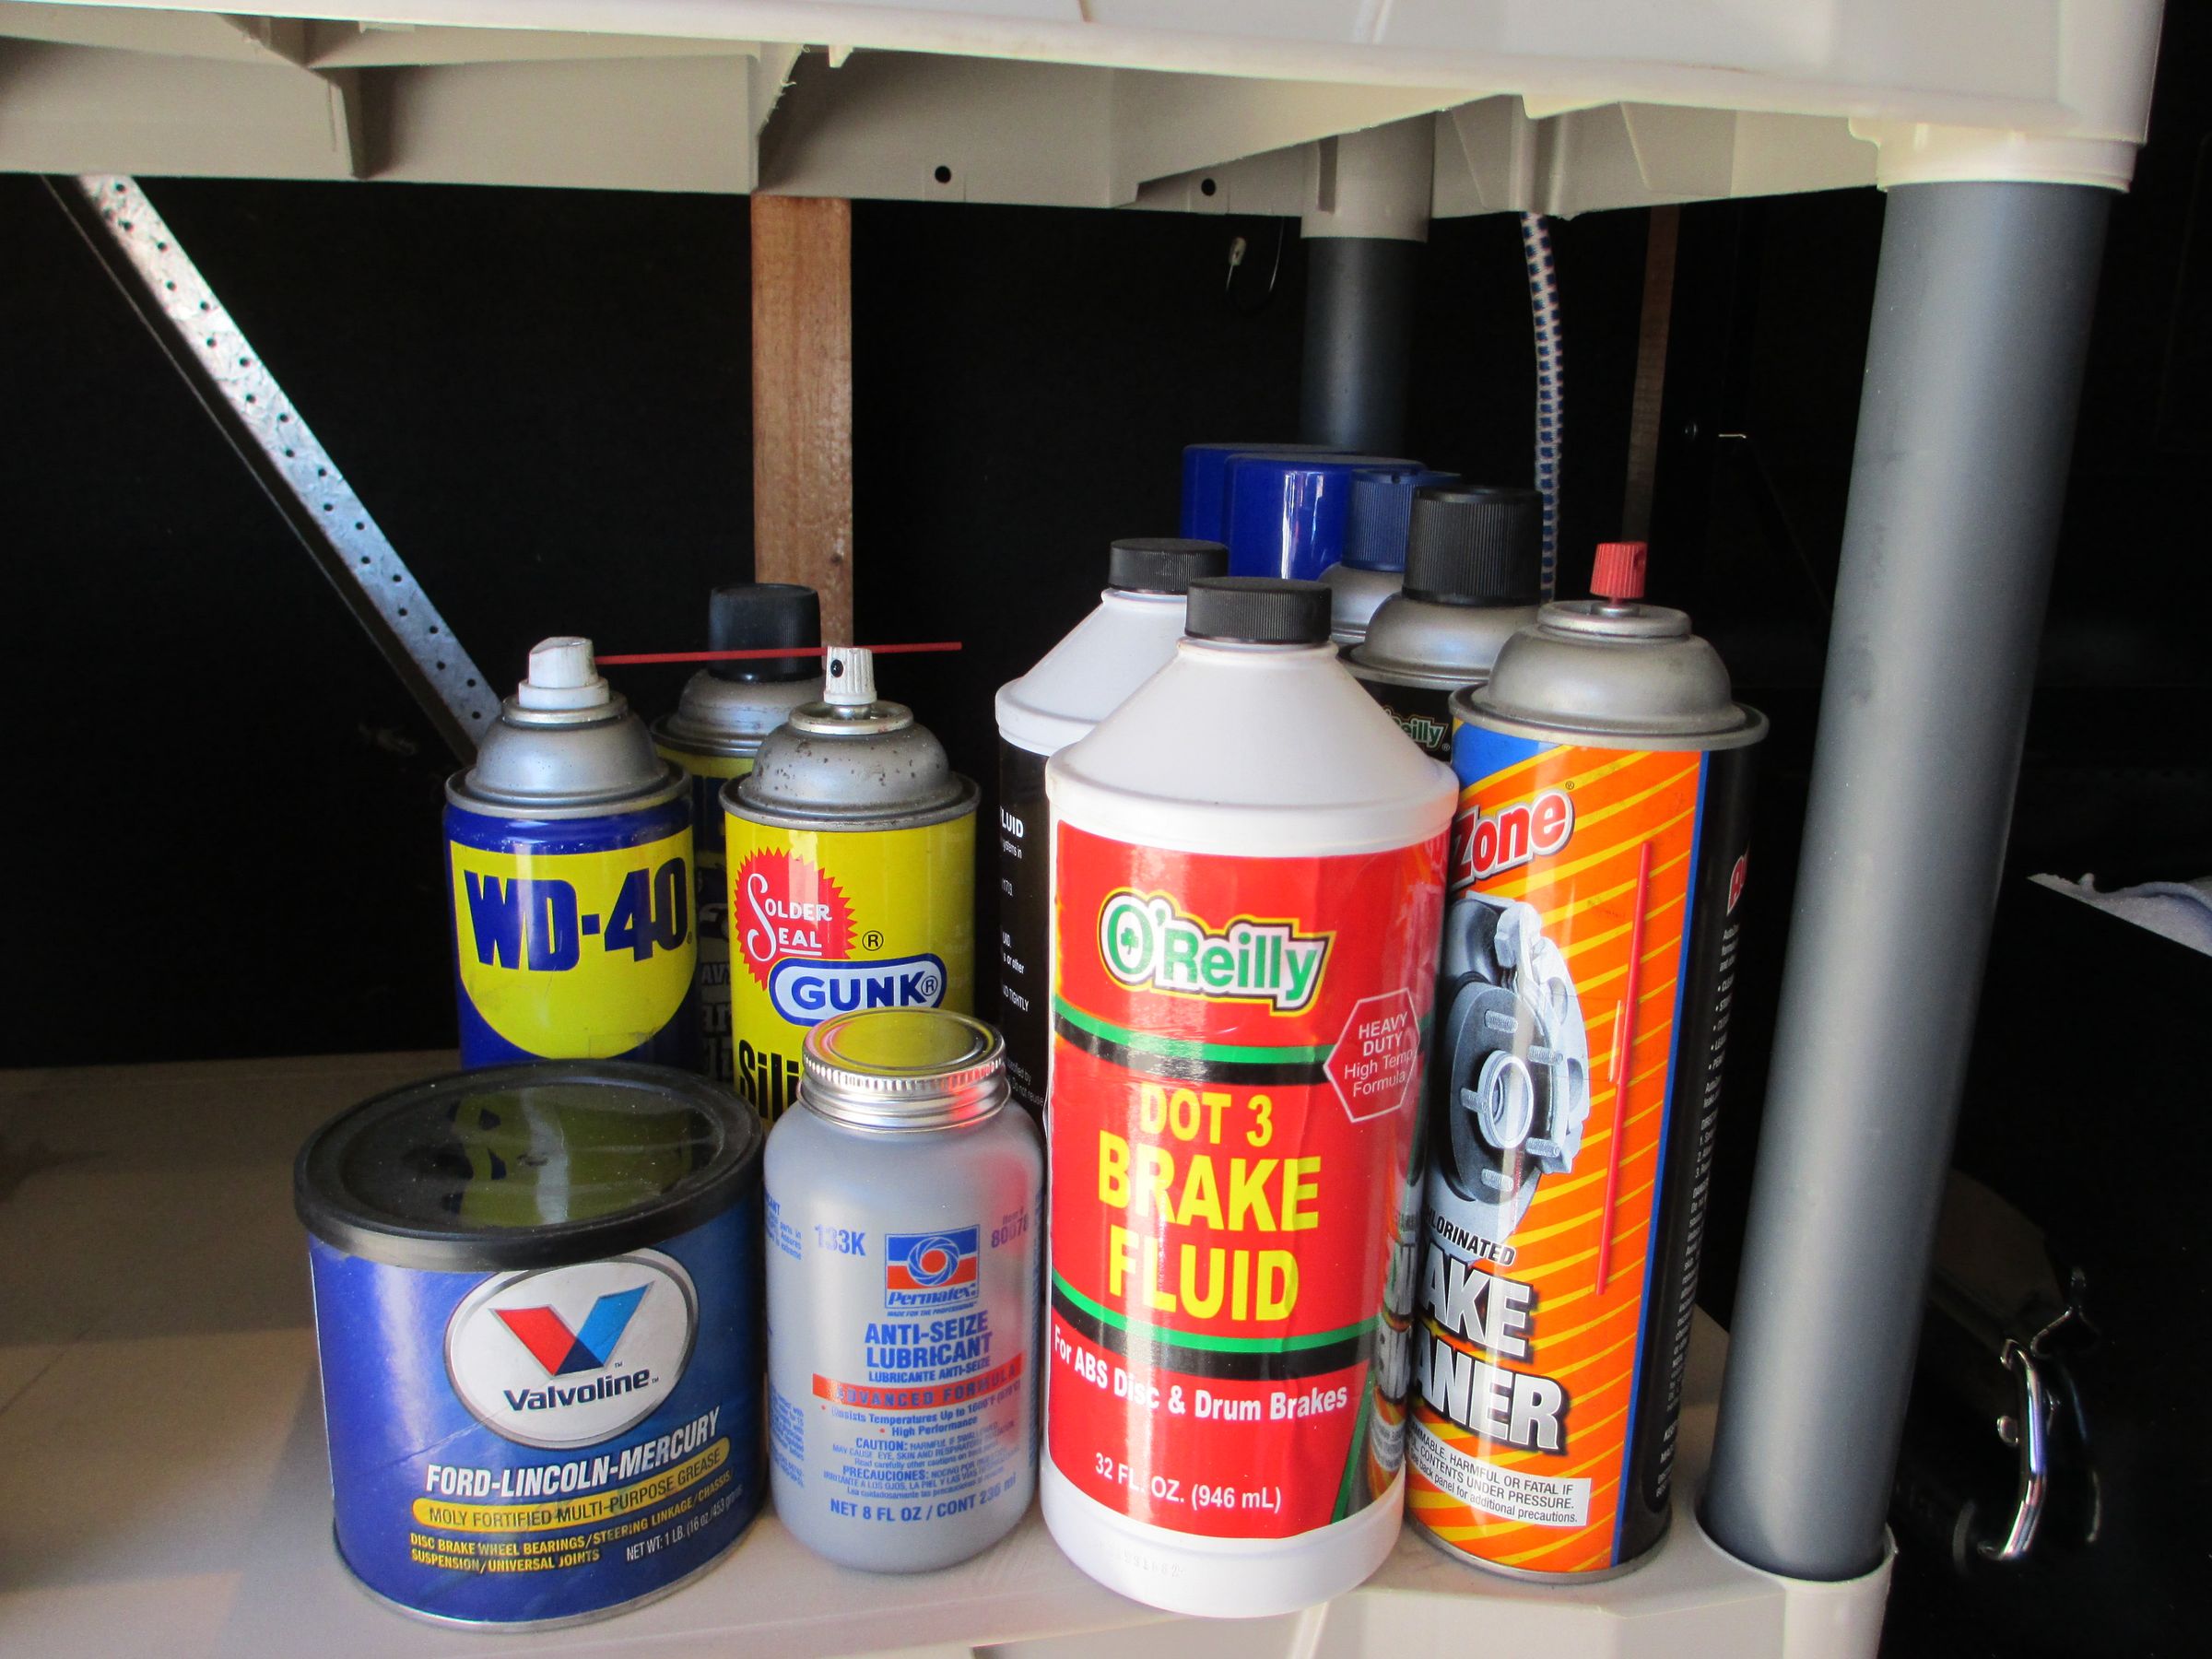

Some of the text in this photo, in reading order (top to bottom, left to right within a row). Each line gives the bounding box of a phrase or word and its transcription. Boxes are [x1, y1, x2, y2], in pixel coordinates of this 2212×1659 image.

[1000, 806, 1024, 838] LUID
[464, 857, 688, 971] WD-40
[747, 874, 832, 922] SOLDER
[1103, 898, 1324, 1006] O'Reilly
[791, 970, 926, 1011] GUNK
[1359, 1011, 1407, 1040] HEAVY
[1363, 1031, 1403, 1057] DUTY
[1344, 1059, 1378, 1080] High
[1352, 1070, 1406, 1098] Formula
[1140, 1081, 1273, 1147] DOT 3
[1099, 1130, 1322, 1233] BRAKE
[1109, 1225, 1300, 1322] FLUID
[865, 1310, 989, 1345] ANTI-SEIZE
[866, 1332, 993, 1369] LUBRICANT
[837, 1364, 1017, 1406] ADVANCED FORMULA
[869, 1357, 990, 1383] LUBRICANTE ANTI-SEIZE
[1054, 1324, 1348, 1420] For ABS Disc & Drum Brakes
[504, 1369, 650, 1411] Valvoline
[869, 1413, 936, 1425] Temperatures
[940, 1410, 953, 1420] Up
[956, 1407, 965, 1418] to
[892, 1426, 915, 1438] High
[918, 1417, 978, 1436] Performance
[426, 1406, 721, 1498] FORD-LINCOLN-MERCURY
[856, 1437, 908, 1451] CAUTION:
[896, 1450, 914, 1460] SKIN
[917, 1449, 934, 1459] AND
[429, 1448, 721, 1527] MOLY FORTIFIED MULTI-PURPOSE GREASE
[842, 1465, 929, 1481] PRECAUCIONES:
[922, 1478, 936, 1488] PIEL
[1095, 1452, 1281, 1513] 32 FL. OZ. (946 mL)
[1419, 1457, 1434, 1479] back
[1434, 1472, 1455, 1493] panel
[1457, 1485, 1468, 1500] for
[1470, 1492, 1515, 1516] additional
[1518, 1506, 1578, 1524] precautions.
[1420, 1447, 1574, 1510] CONTENTS UNDER PRESSURE.
[1450, 1453, 1499, 1485] HARMFUL
[1504, 1475, 1520, 1489] OR
[1524, 1480, 1559, 1495] FATAL
[1562, 1484, 1574, 1495] IF
[830, 1497, 858, 1517] NET
[863, 1505, 872, 1520] 8
[877, 1507, 895, 1521] FL
[900, 1506, 922, 1521] OZ
[937, 1493, 976, 1517] CONT
[410, 1533, 435, 1547] DISC
[438, 1538, 477, 1555] BRAKE
[477, 1542, 520, 1556] WHEEL
[411, 1548, 601, 1574] SUSPENSION/UNIVERSAL JOINTS
[627, 1542, 645, 1561] NET
[646, 1537, 664, 1555] WT:
[665, 1534, 670, 1547] 1
[672, 1525, 686, 1543] LB.
